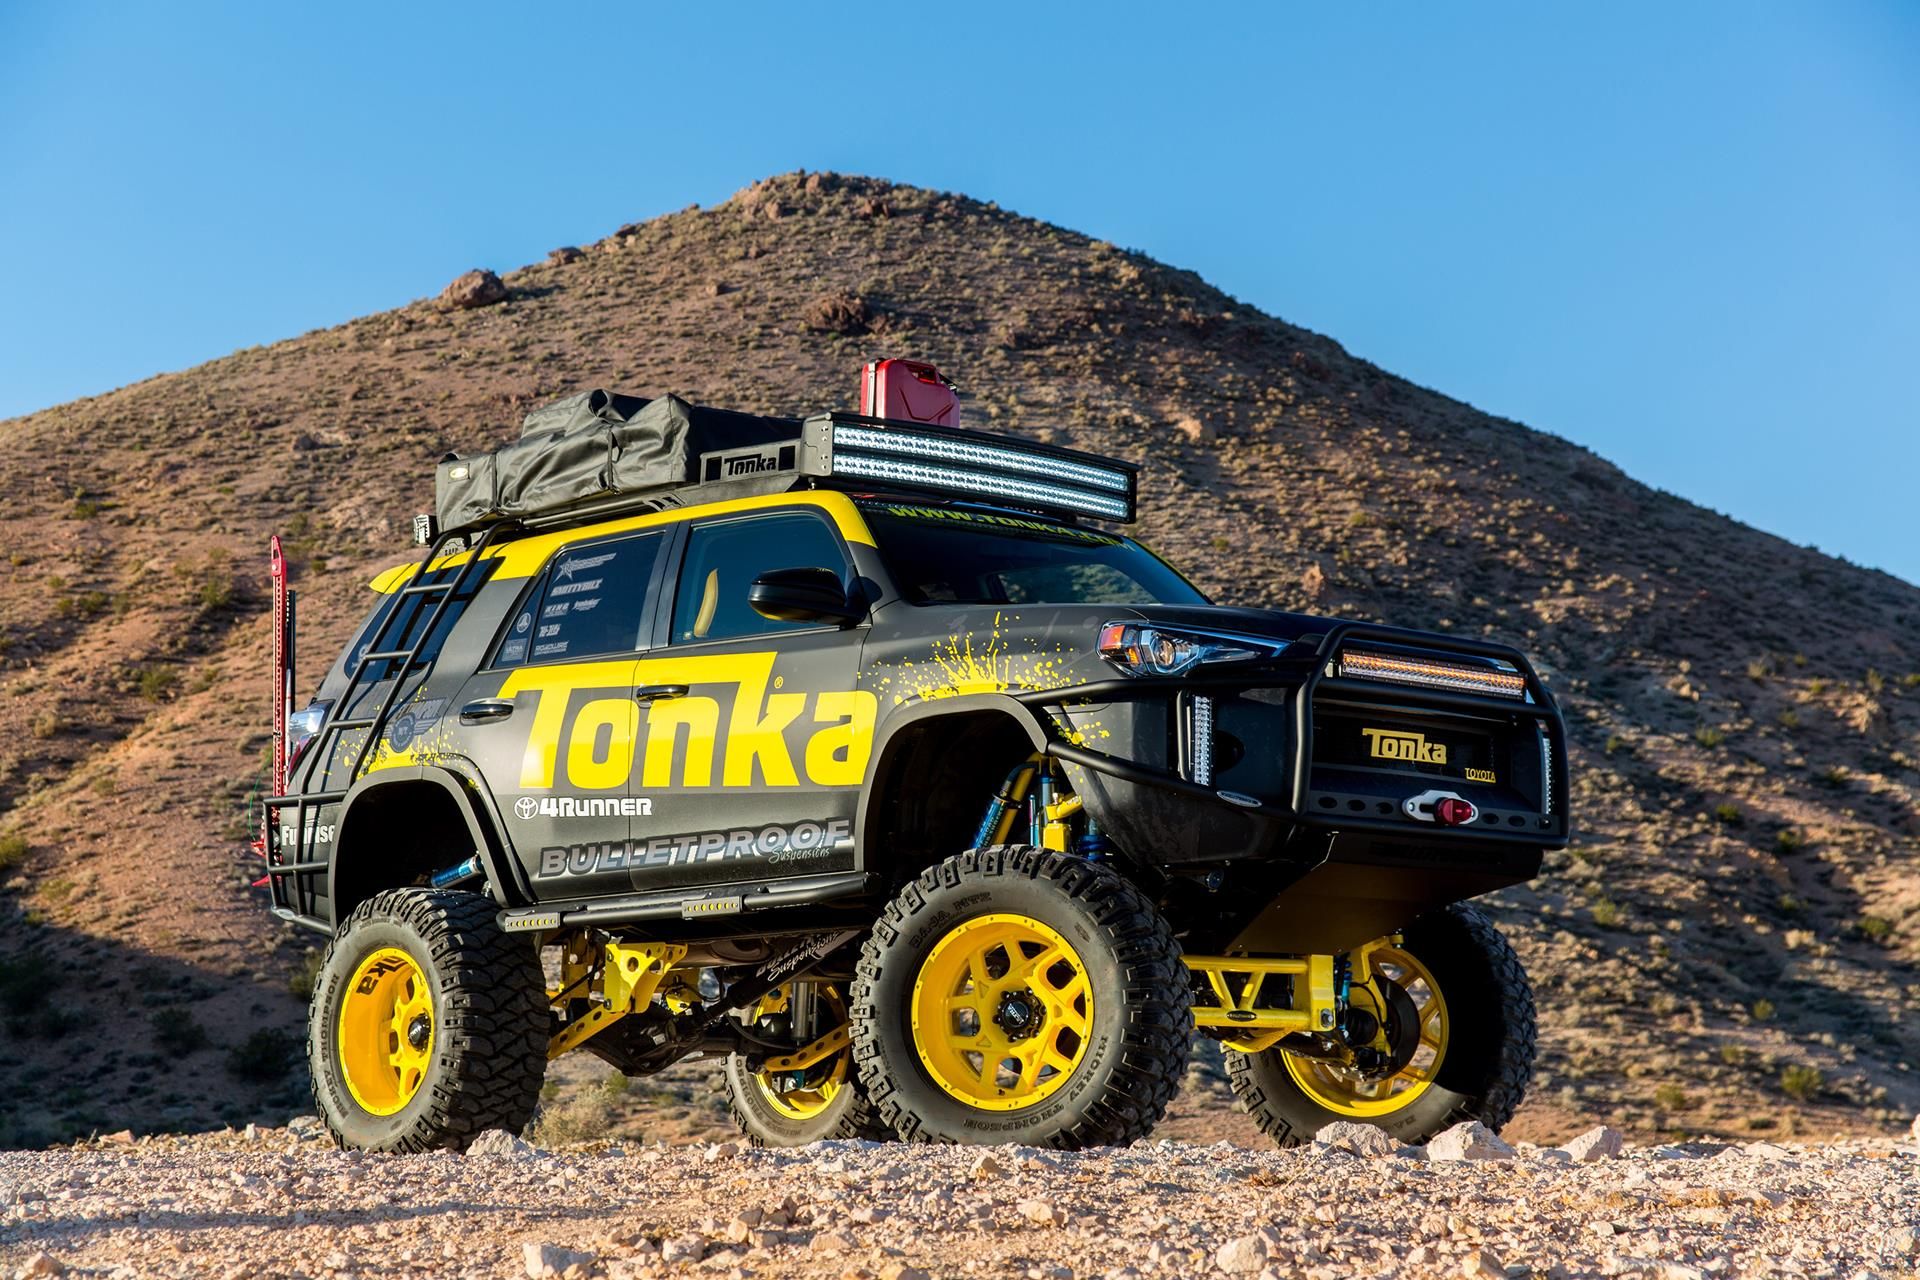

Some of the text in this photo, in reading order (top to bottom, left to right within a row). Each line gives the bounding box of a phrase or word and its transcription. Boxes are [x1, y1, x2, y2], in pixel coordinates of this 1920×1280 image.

[723, 453, 777, 475] Tonka
[496, 651, 878, 789] Tonka
[1362, 727, 1447, 764] Tonka
[1464, 767, 1496, 783] TOYOTA
[538, 817, 853, 878] BULLETPROOF
[768, 846, 830, 865] Suspensions
